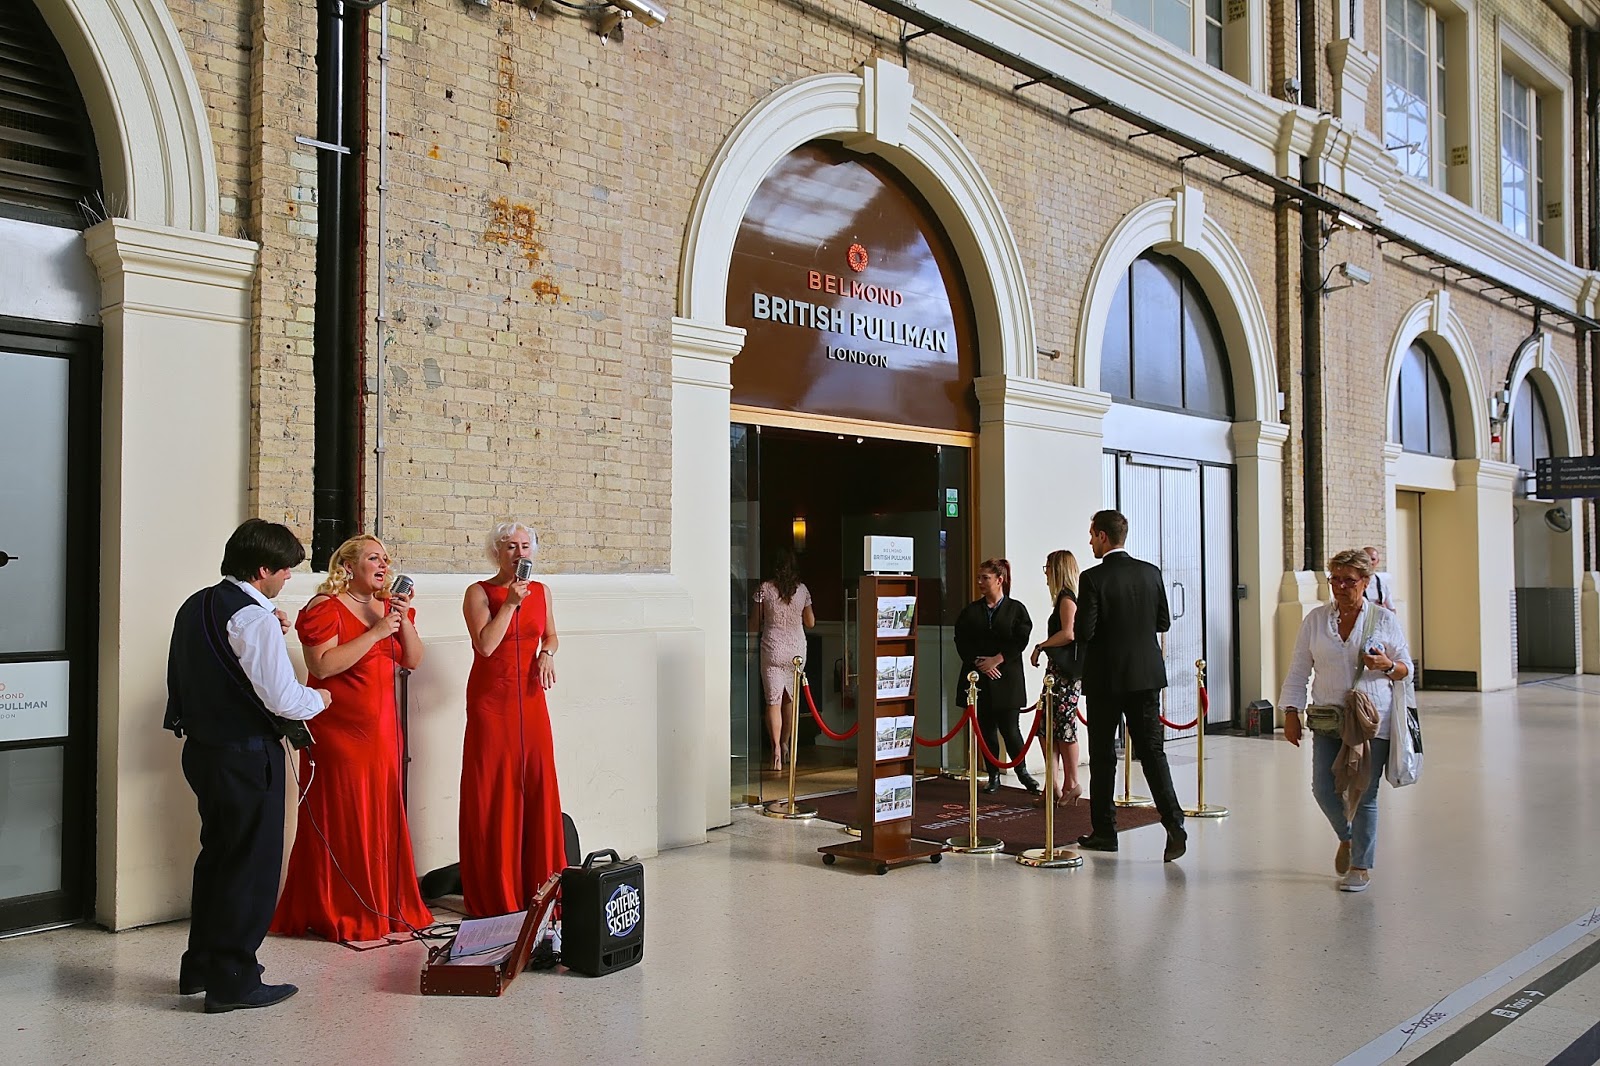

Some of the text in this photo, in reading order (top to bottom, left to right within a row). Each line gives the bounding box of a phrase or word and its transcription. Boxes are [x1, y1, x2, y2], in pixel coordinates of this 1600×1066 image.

[808, 270, 904, 308] BELMOND
[753, 292, 948, 353] BRITISH PULLMAN
[827, 345, 889, 368] LONDON
[0, 700, 48, 711] PULLMAN
[605, 888, 641, 920] SPITFIRE
[608, 905, 641, 936] SISTERS
